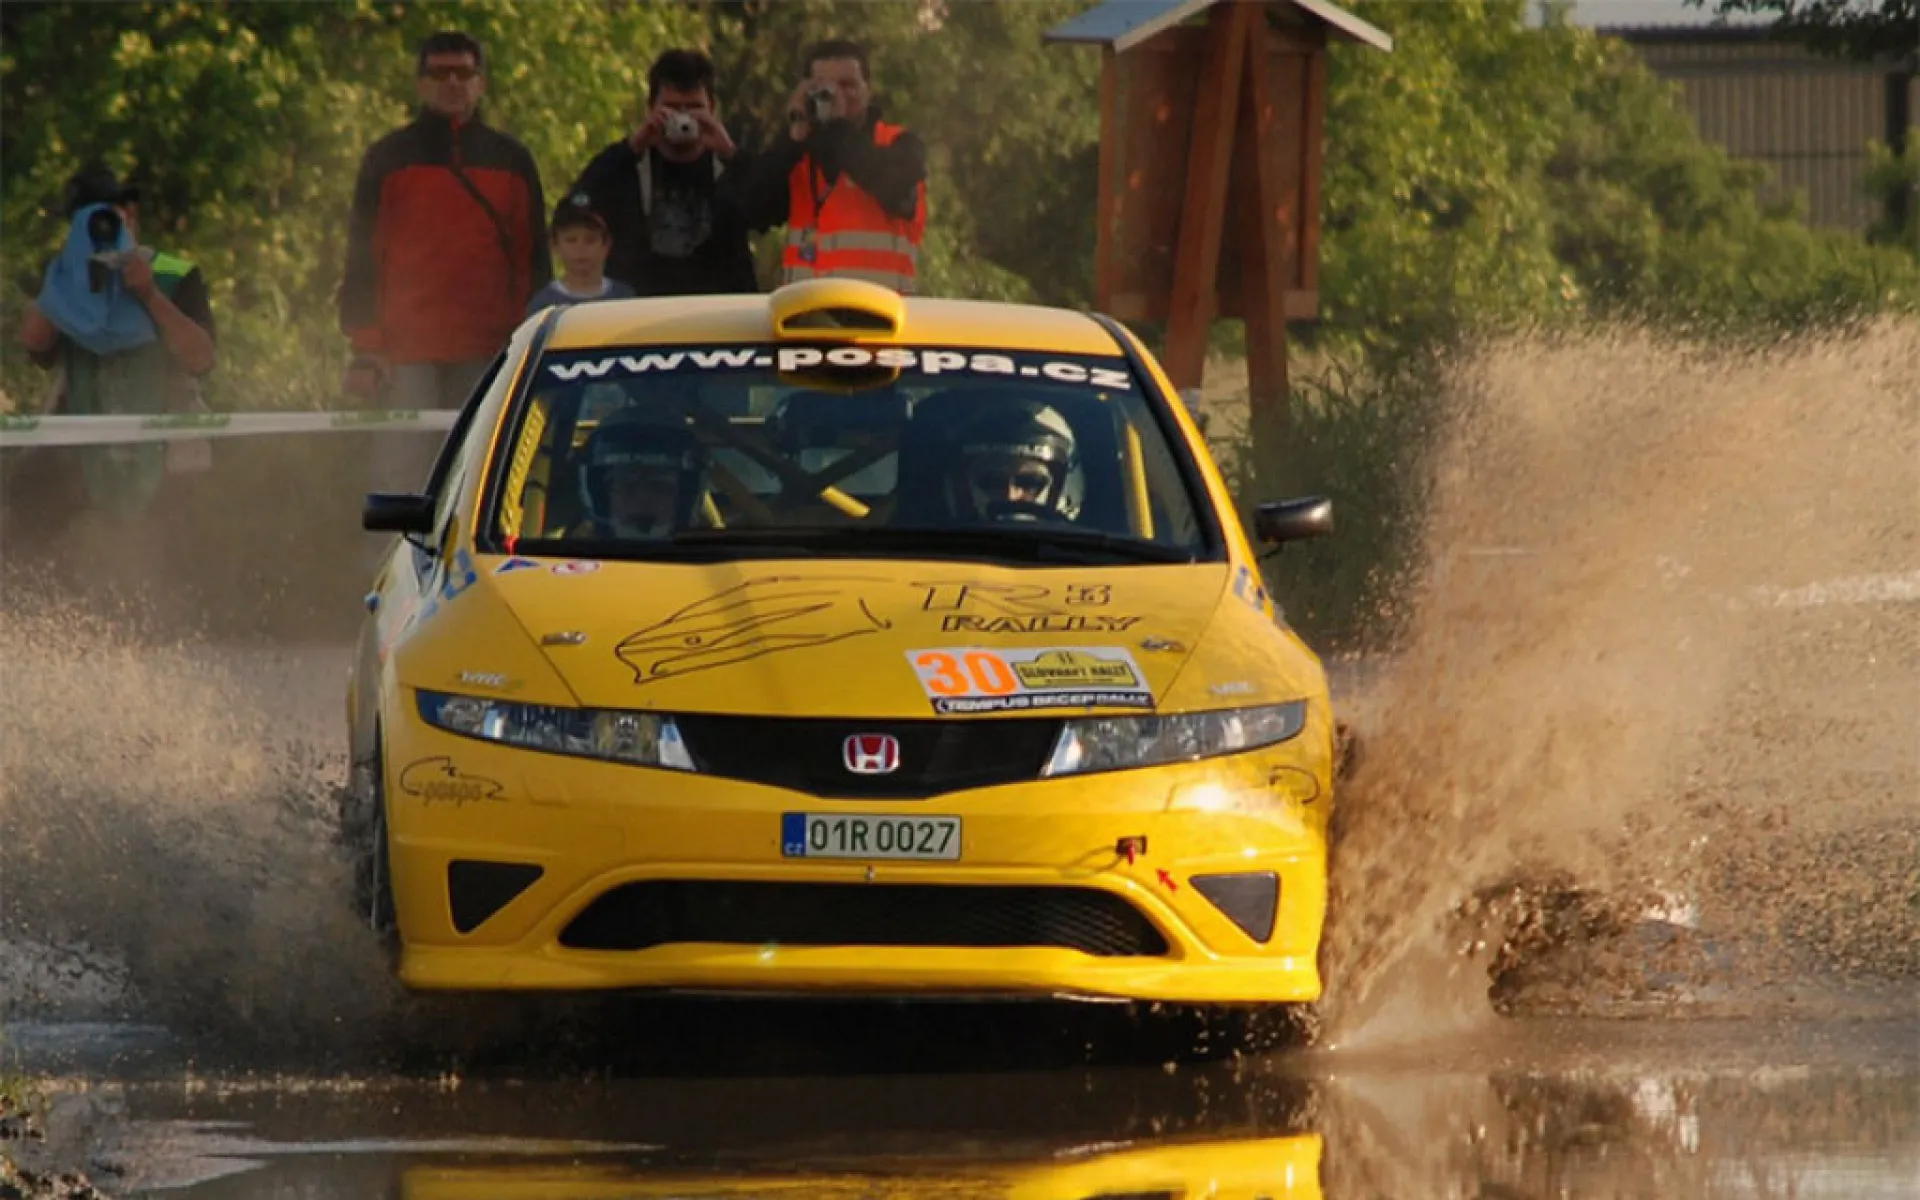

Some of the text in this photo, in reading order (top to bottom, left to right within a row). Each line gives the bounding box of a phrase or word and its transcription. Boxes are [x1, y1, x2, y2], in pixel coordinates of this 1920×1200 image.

[548, 348, 1131, 390] www.pospa.cz
[941, 615, 1144, 632] RALLY
[915, 650, 1019, 695] 30
[784, 842, 804, 856] CZ
[809, 819, 957, 854] 01R 0027
